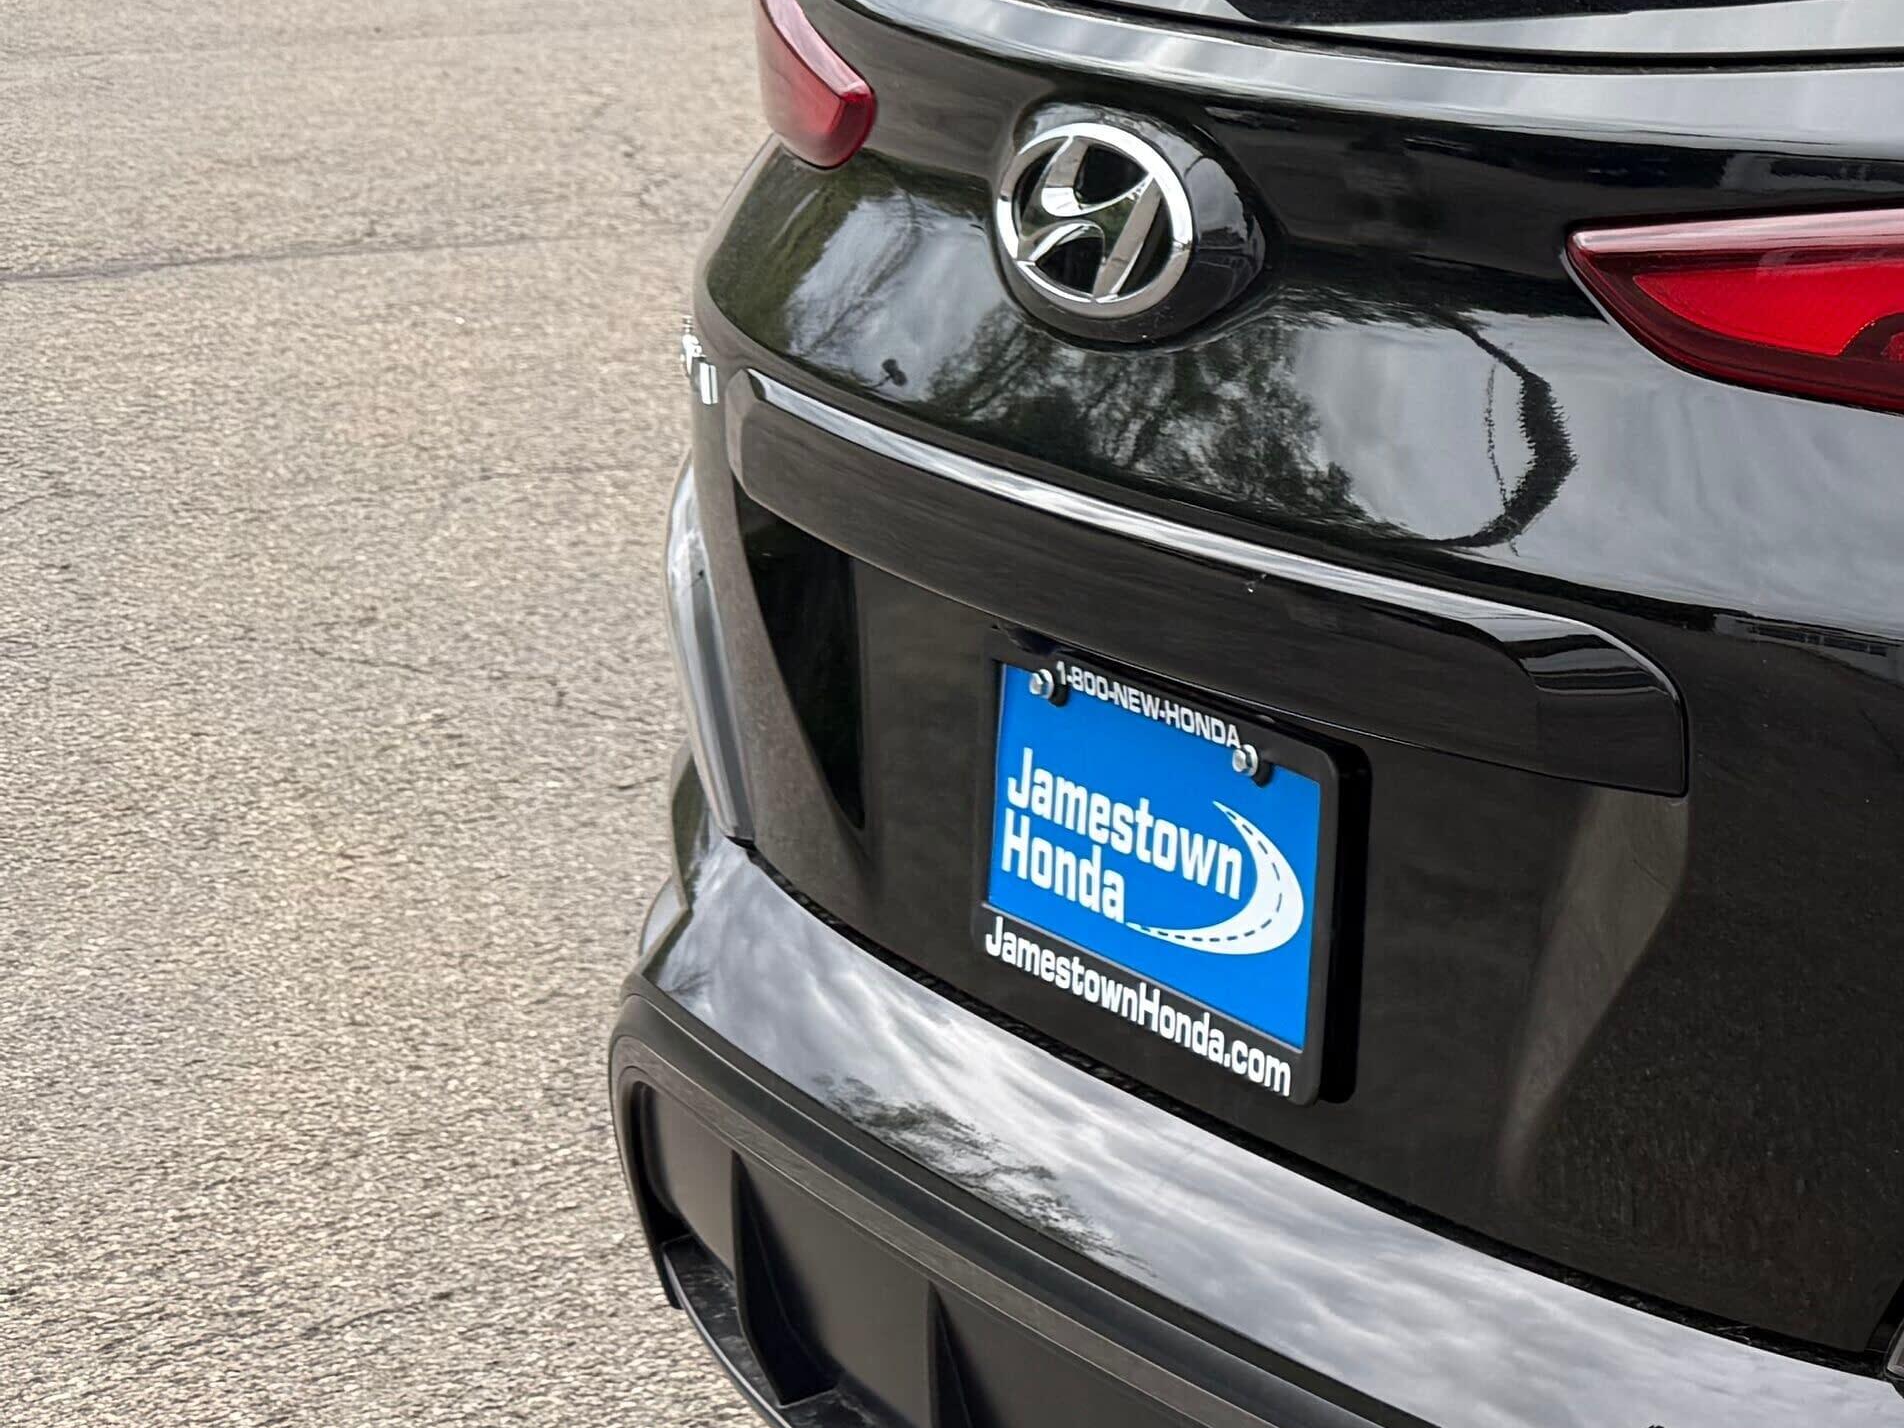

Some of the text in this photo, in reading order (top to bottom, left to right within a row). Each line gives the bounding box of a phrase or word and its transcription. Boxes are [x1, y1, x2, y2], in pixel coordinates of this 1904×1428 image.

[1056, 661, 1241, 749] 1-800-NEW-HONDA
[1001, 809, 1126, 925] Honda
[1007, 748, 1244, 901] Jamestown
[985, 915, 1293, 1098] JamestownHonda.com
